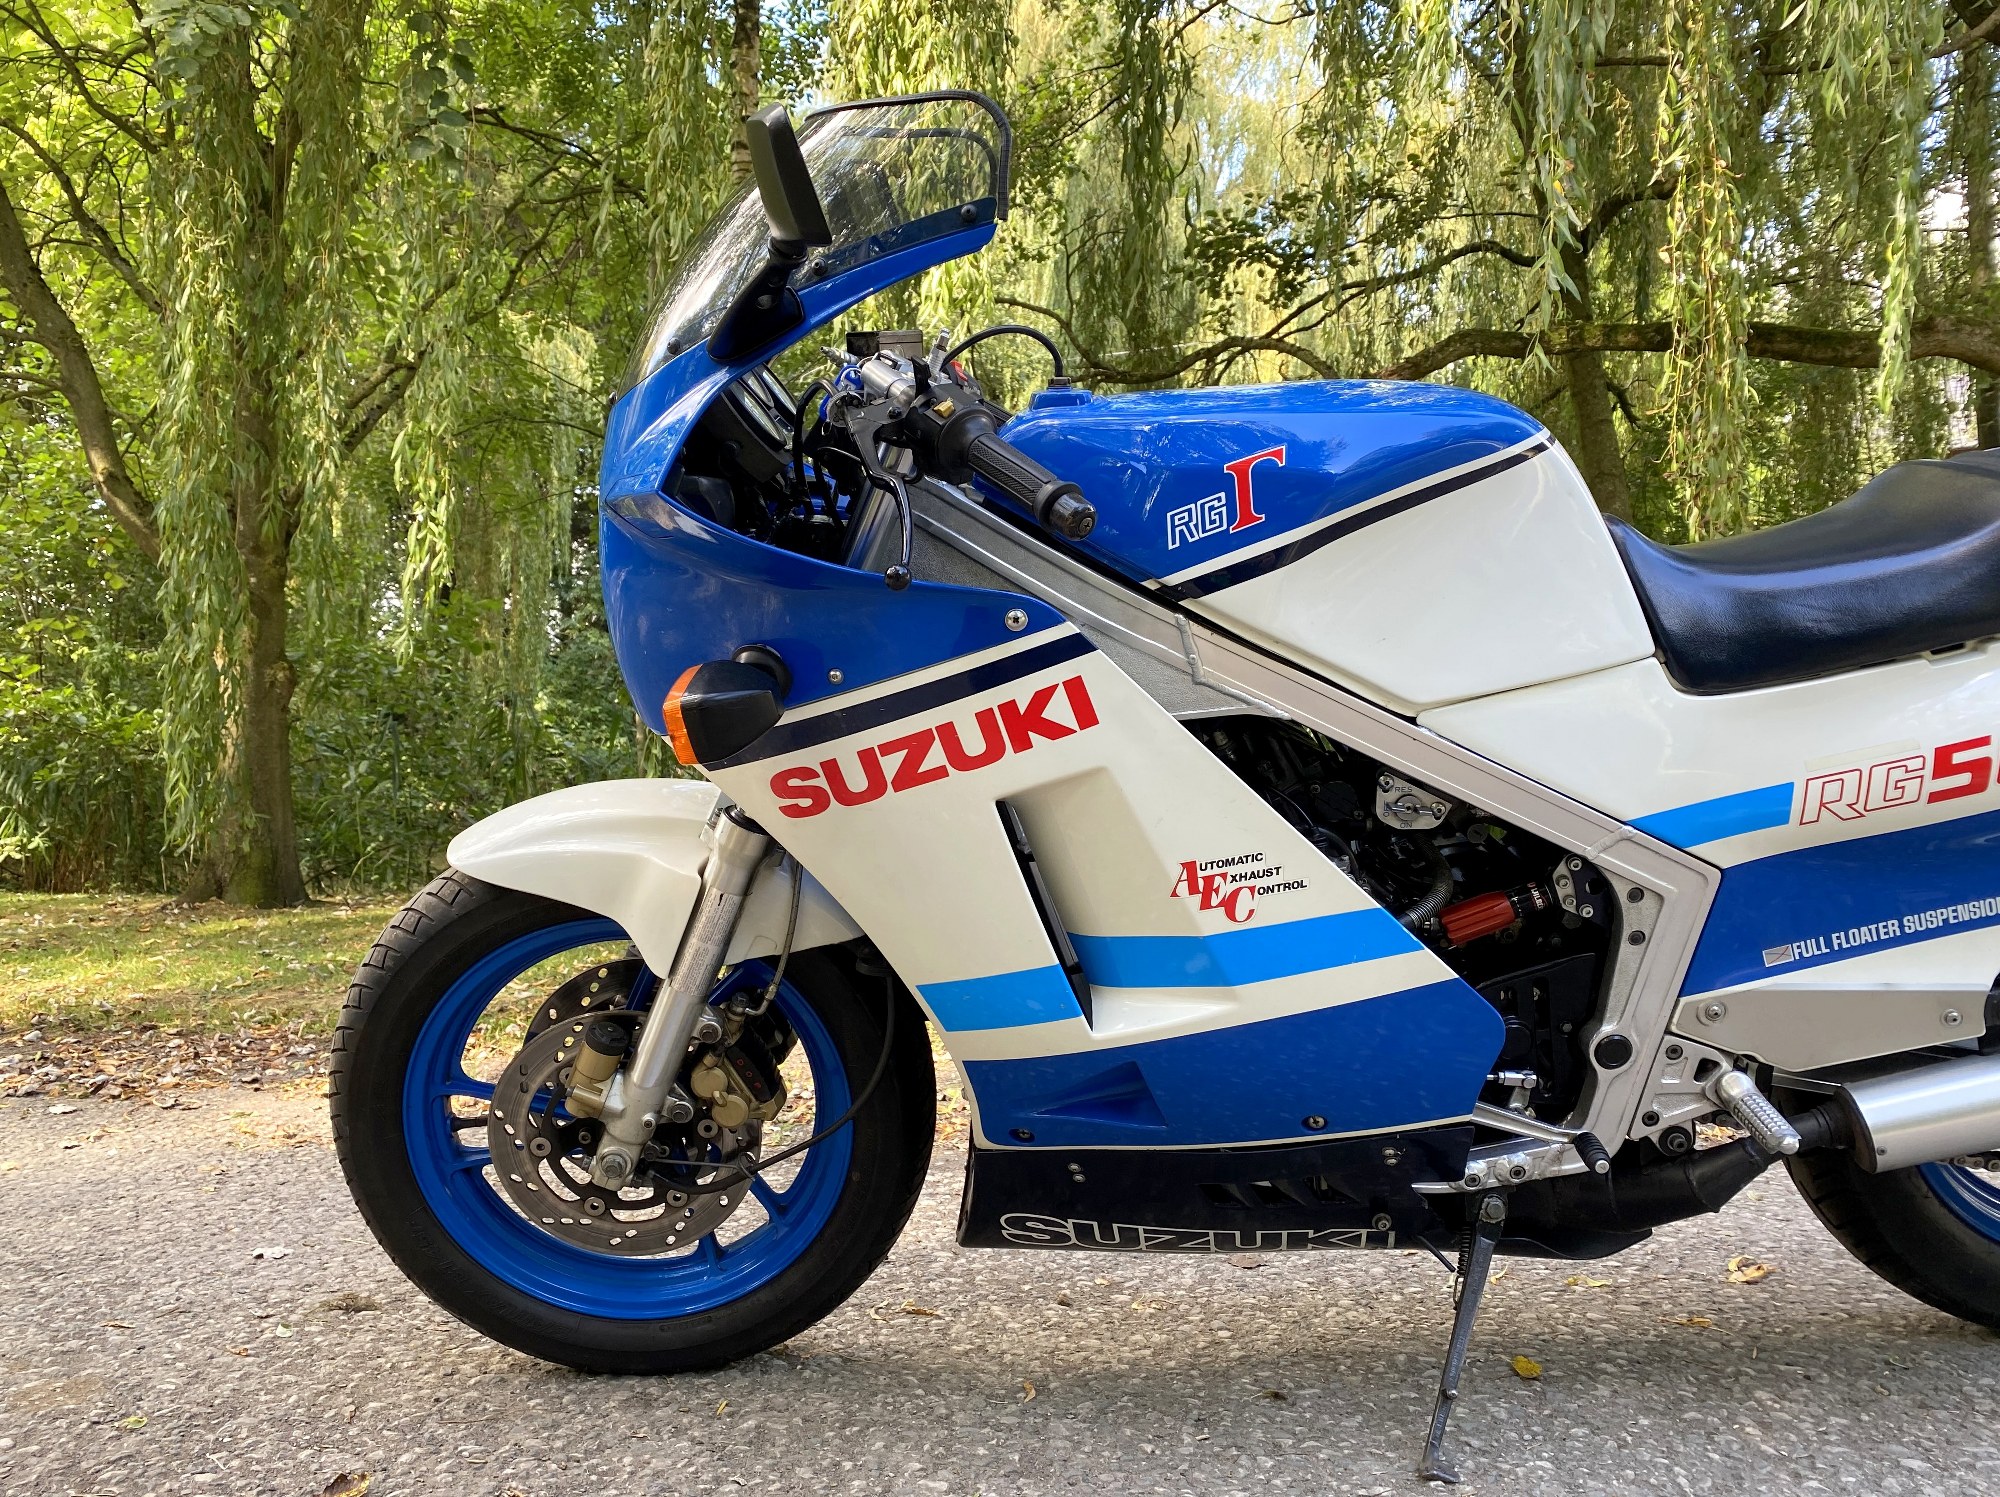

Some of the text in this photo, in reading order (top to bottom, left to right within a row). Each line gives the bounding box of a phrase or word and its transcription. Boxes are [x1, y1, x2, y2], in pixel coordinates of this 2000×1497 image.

[769, 674, 1100, 819] SUZUKI
[1799, 734, 2000, 826] RG5
[1792, 936, 1831, 960] FULL
[1831, 918, 1902, 951] FLOATER
[1000, 1213, 1396, 1253] SUZUKI
